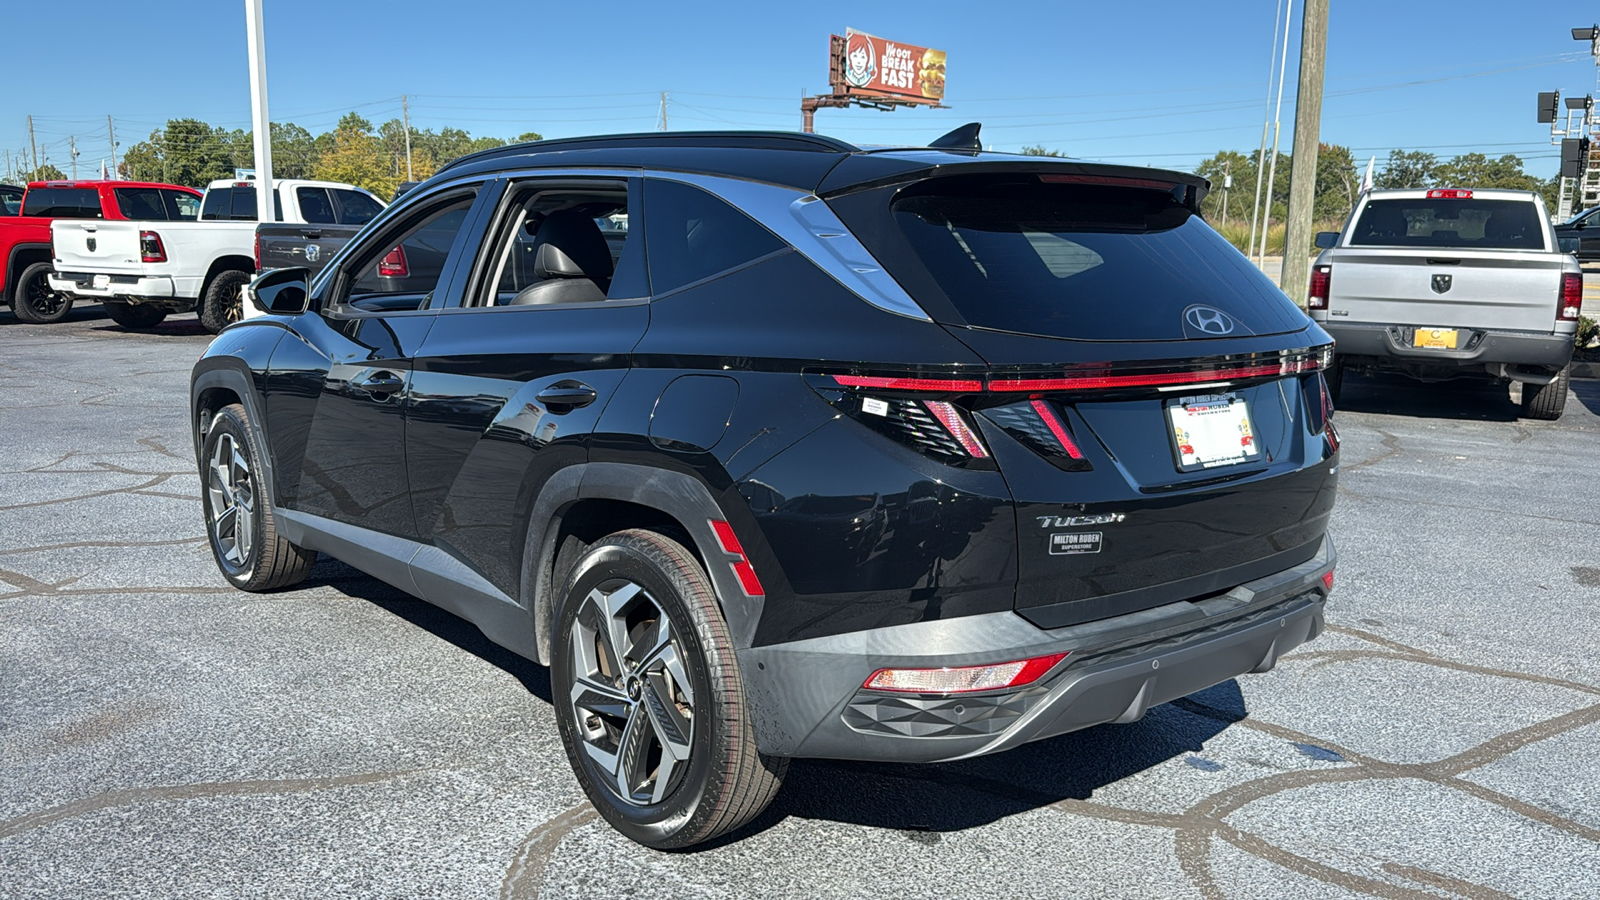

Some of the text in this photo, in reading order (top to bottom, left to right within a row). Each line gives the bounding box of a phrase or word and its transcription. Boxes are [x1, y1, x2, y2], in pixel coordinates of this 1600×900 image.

[896, 48, 911, 59] GOT
[881, 54, 915, 72] BREAK
[881, 67, 915, 89] FAST
[1053, 533, 1100, 544] MILTON RUBEN
